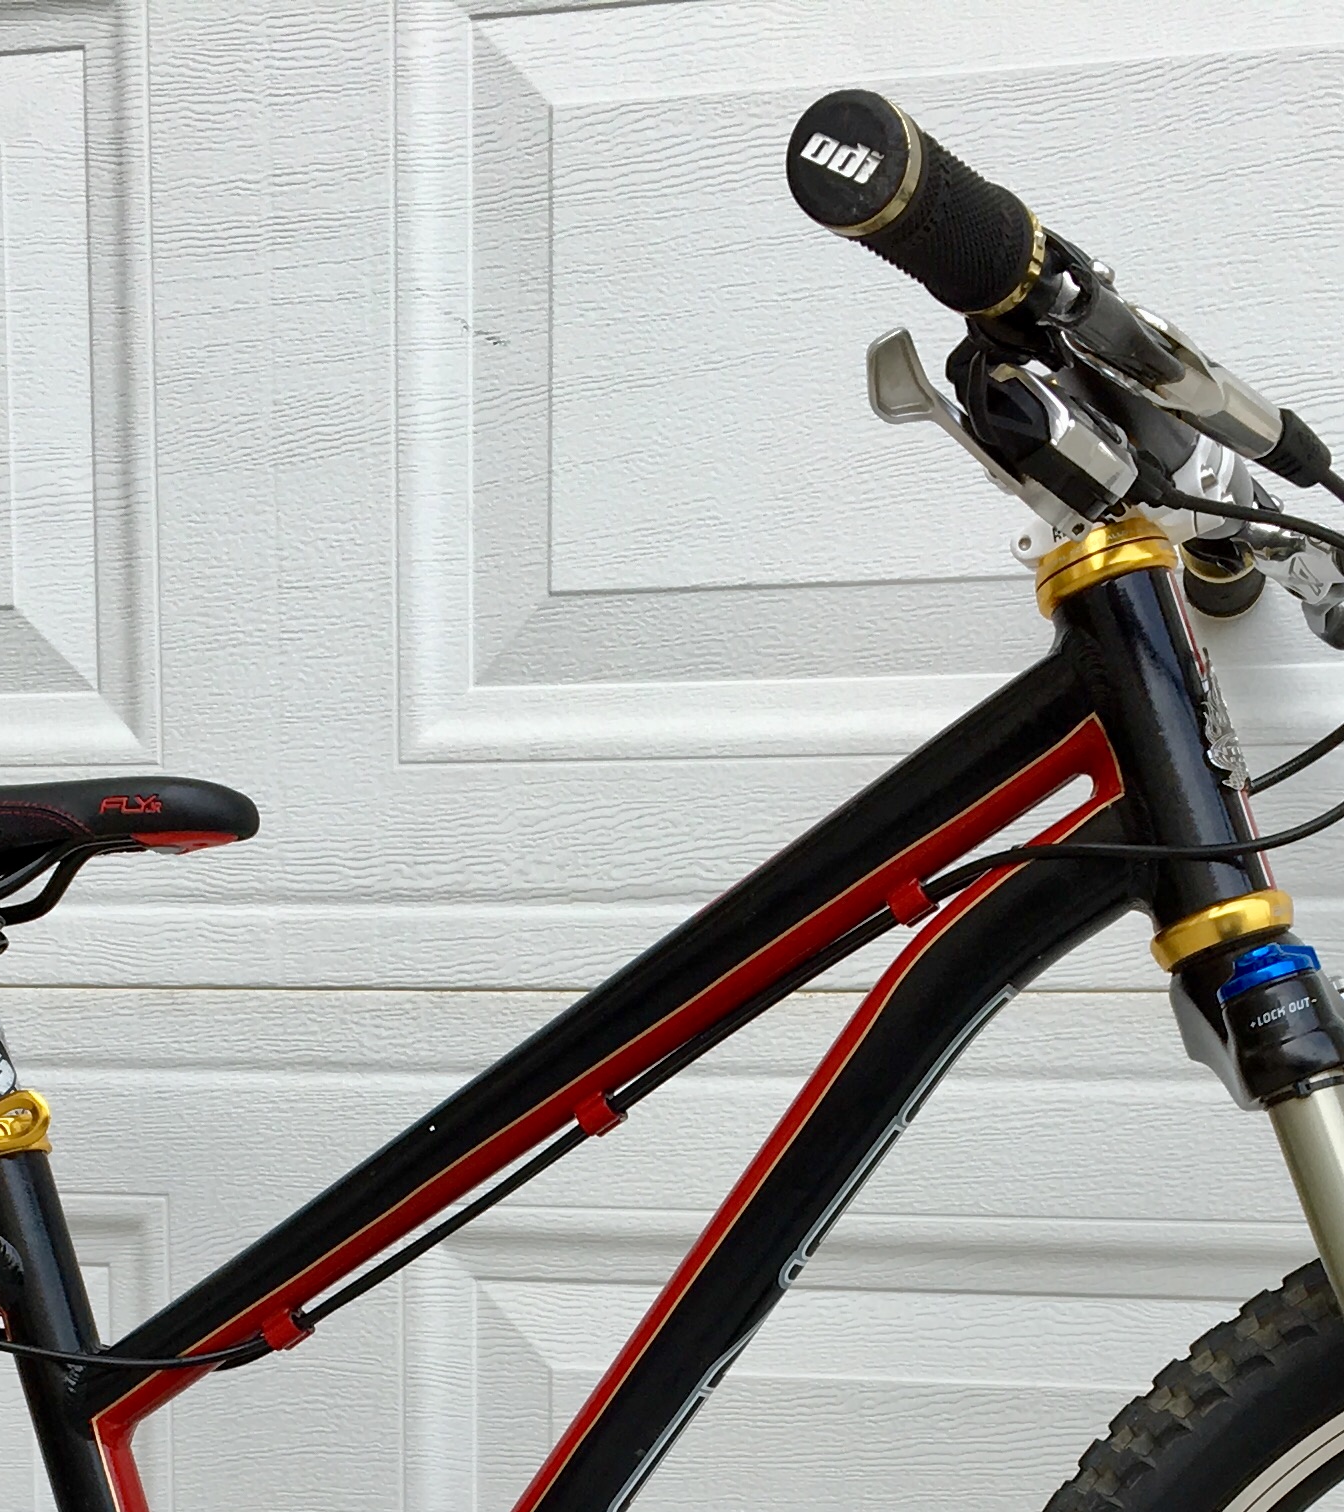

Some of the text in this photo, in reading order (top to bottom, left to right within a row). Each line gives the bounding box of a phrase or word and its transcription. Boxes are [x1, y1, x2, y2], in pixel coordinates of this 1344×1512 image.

[99, 794, 160, 814] FLY
[1257, 997, 1310, 1027] LOCK OUT
